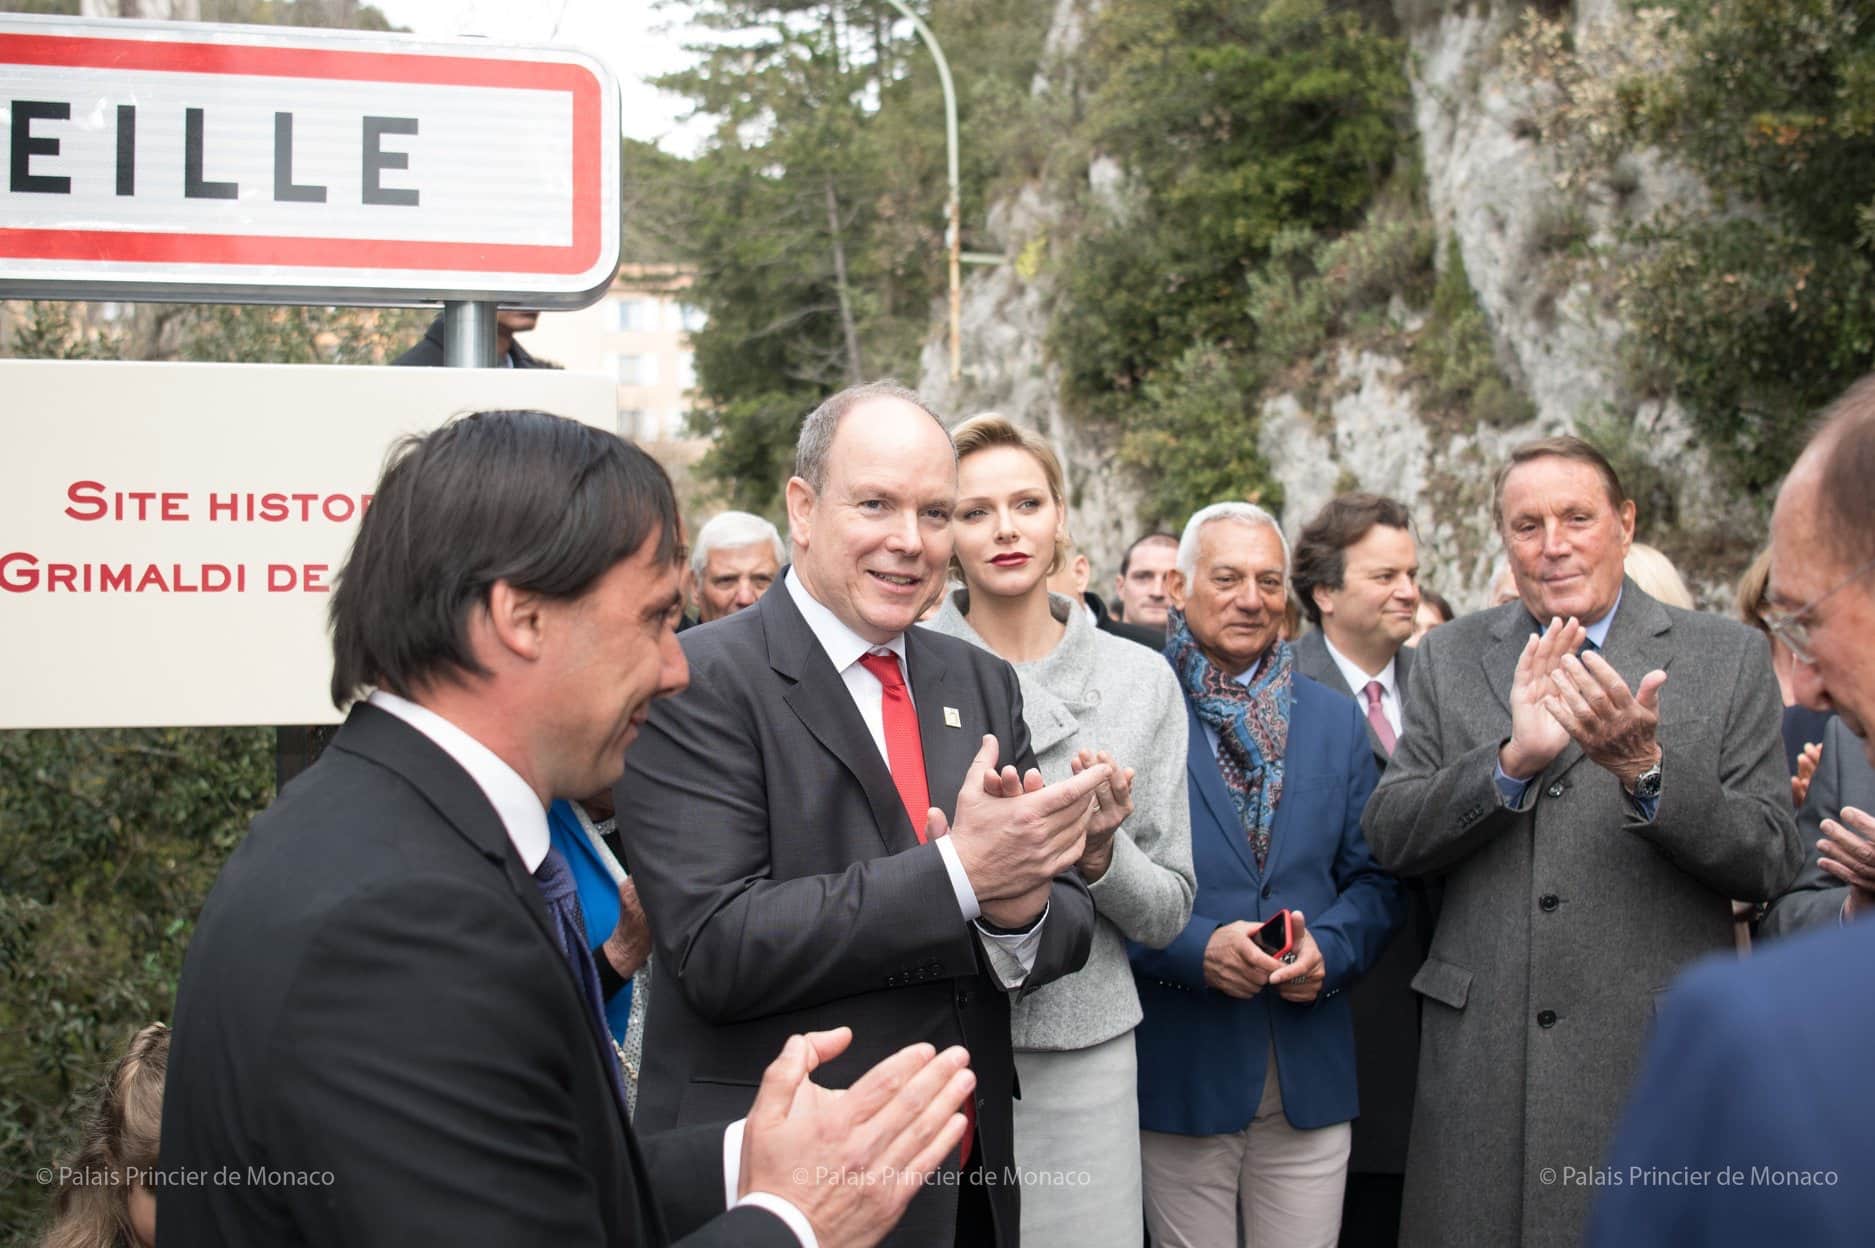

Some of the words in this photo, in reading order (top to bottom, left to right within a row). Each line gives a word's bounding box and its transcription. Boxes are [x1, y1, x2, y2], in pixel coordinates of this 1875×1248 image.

[10, 100, 420, 207] EILLE
[209, 493, 376, 522] HISTO
[267, 564, 330, 593] DE
